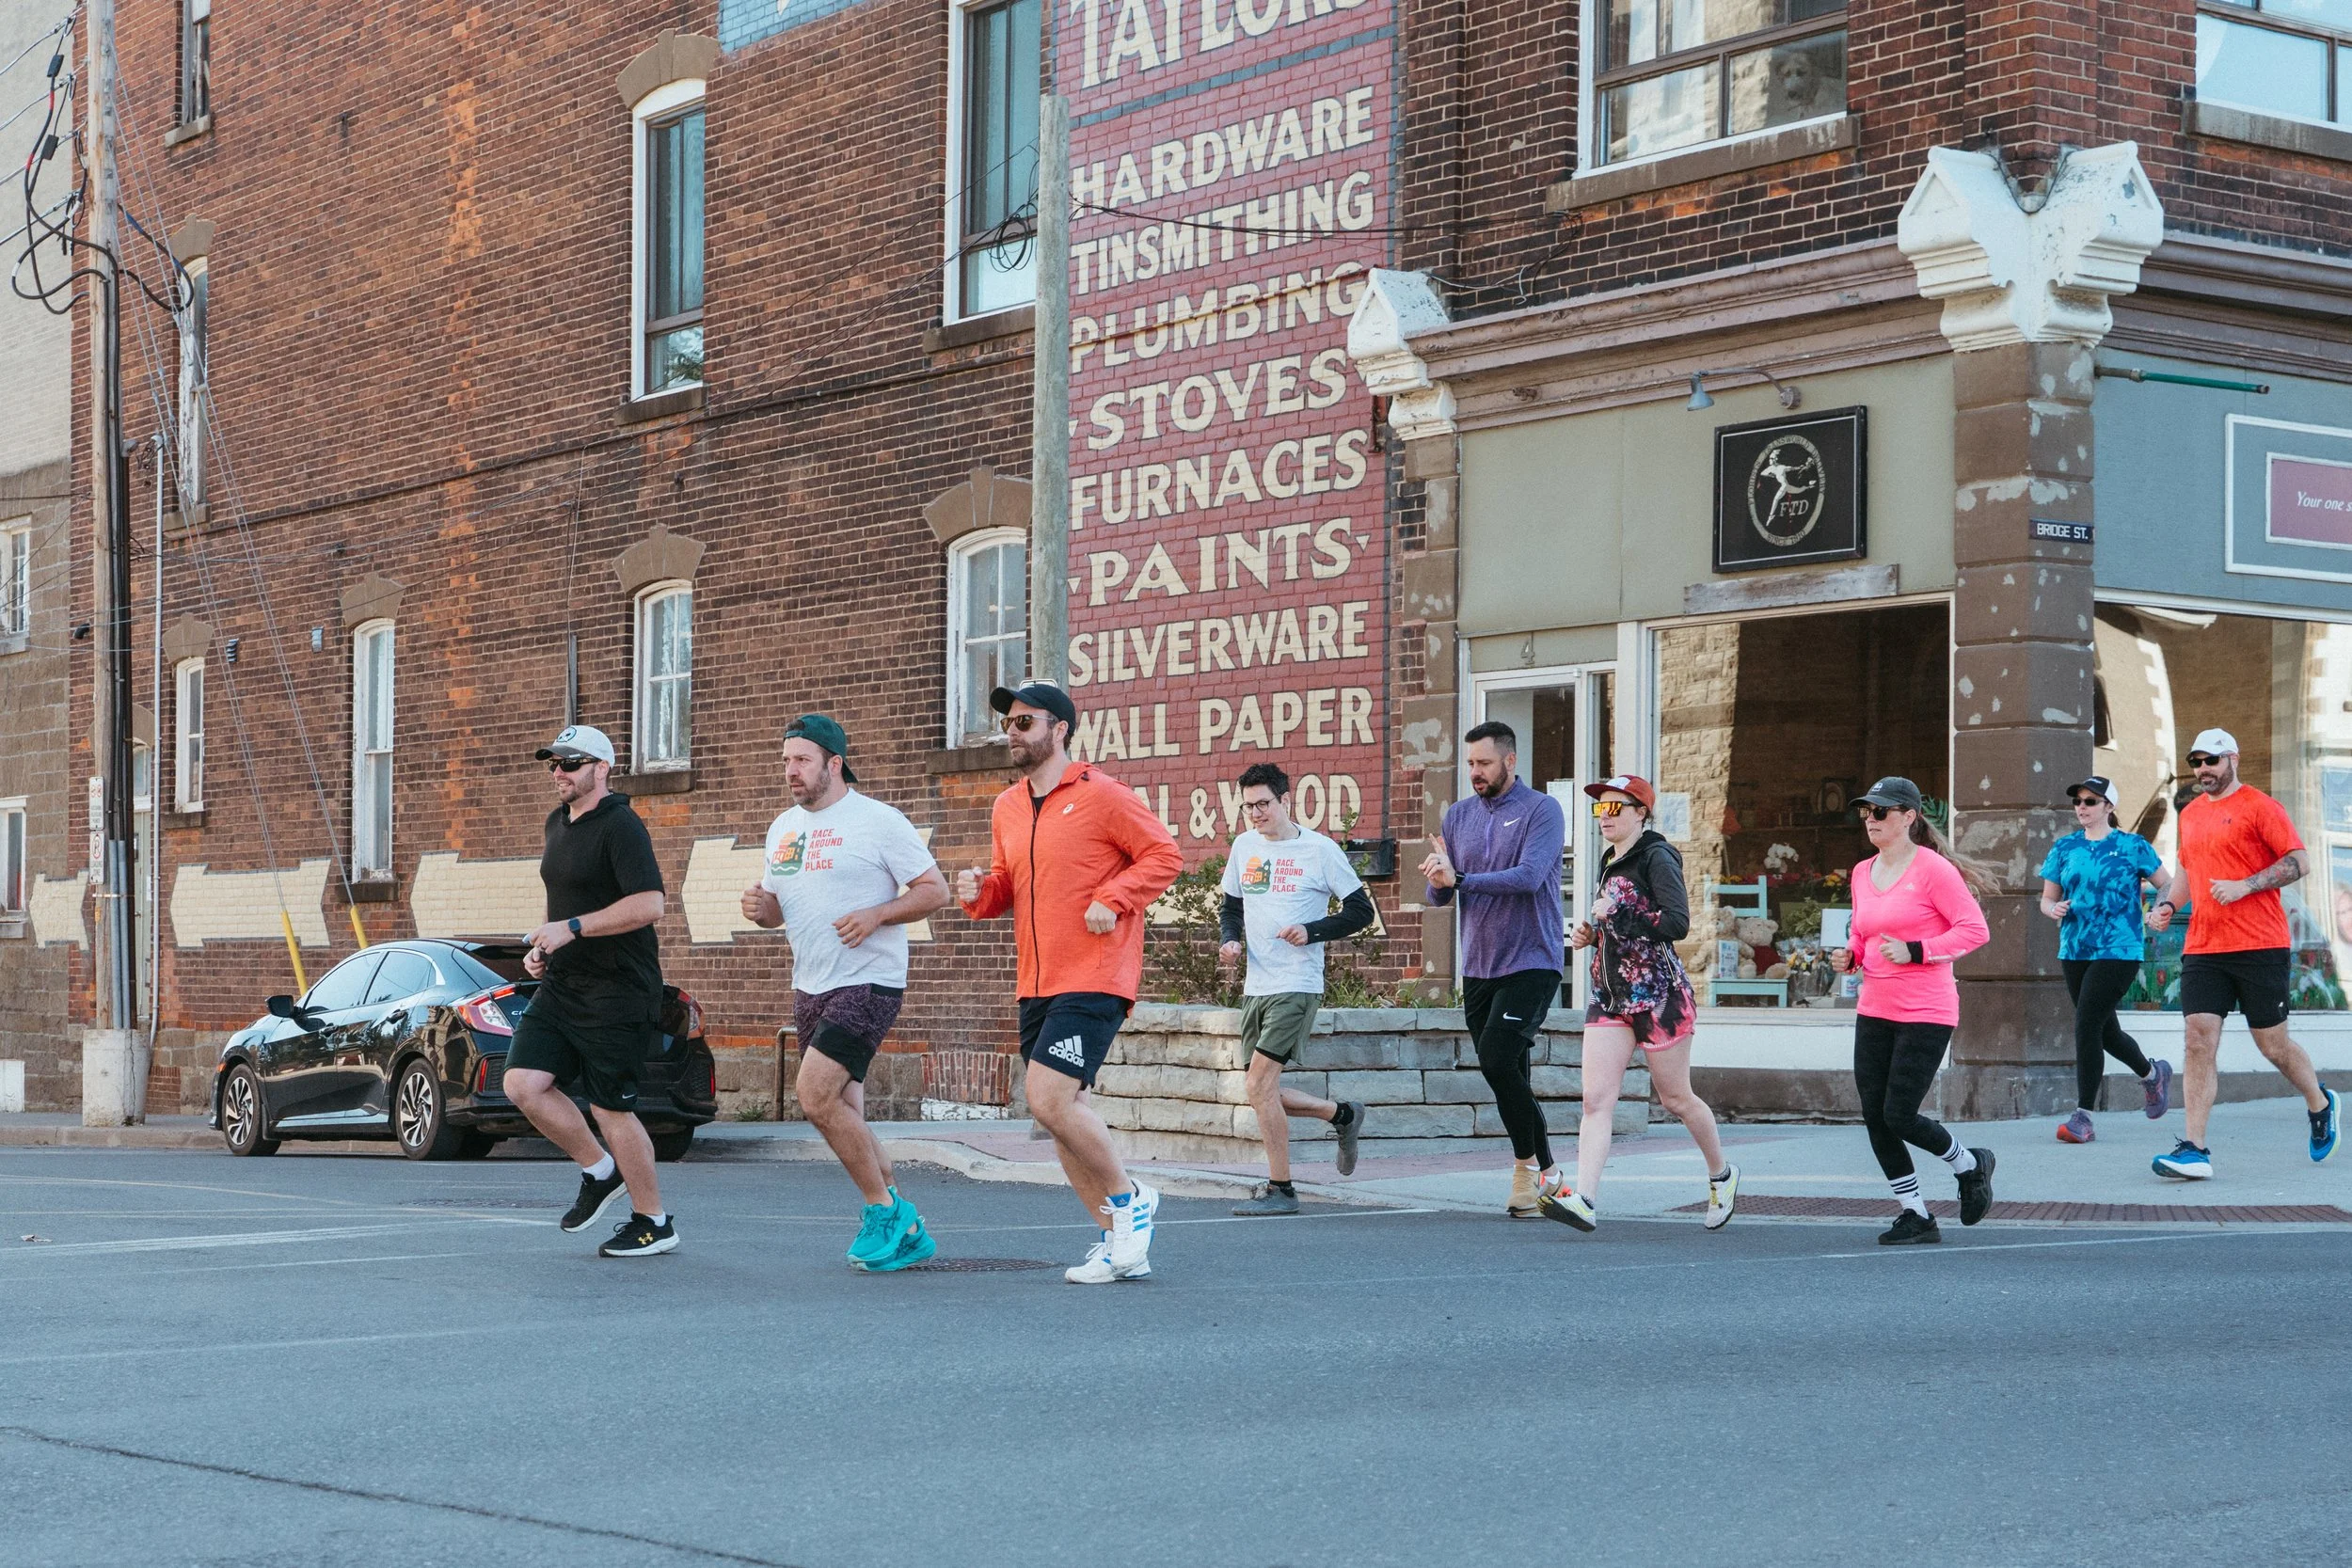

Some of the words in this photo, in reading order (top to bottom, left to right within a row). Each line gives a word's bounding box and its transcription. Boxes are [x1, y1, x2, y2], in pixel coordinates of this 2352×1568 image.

[1073, 86, 1374, 221] HARDWARE
[1071, 170, 1374, 295] TINSMITHING
[1071, 261, 1368, 374] PLUMBING
[1089, 348, 1347, 450] STOVES
[1071, 429, 1369, 531] FURNACES
[1779, 499, 1810, 516] FTD
[2297, 491, 2322, 509] Your
[2325, 499, 2344, 511] one
[2037, 523, 2071, 537] BRIDGE
[2074, 526, 2089, 540] ST.
[1085, 516, 1352, 607] PAINTS
[1069, 601, 1370, 688] SILVERWARE
[1071, 703, 1180, 763] WALL
[1199, 687, 1375, 754] PAPER
[1216, 772, 1362, 833] WOD
[809, 837, 843, 849] AROUND
[812, 829, 834, 839] RACE
[807, 849, 821, 860] THE
[1276, 859, 1295, 867] RACE
[805, 859, 834, 872] PLACE
[1275, 867, 1304, 877] AROUND
[1272, 884, 1296, 893] PLACE
[1273, 876, 1287, 884] THE
[1048, 1045, 1085, 1068] adidas
